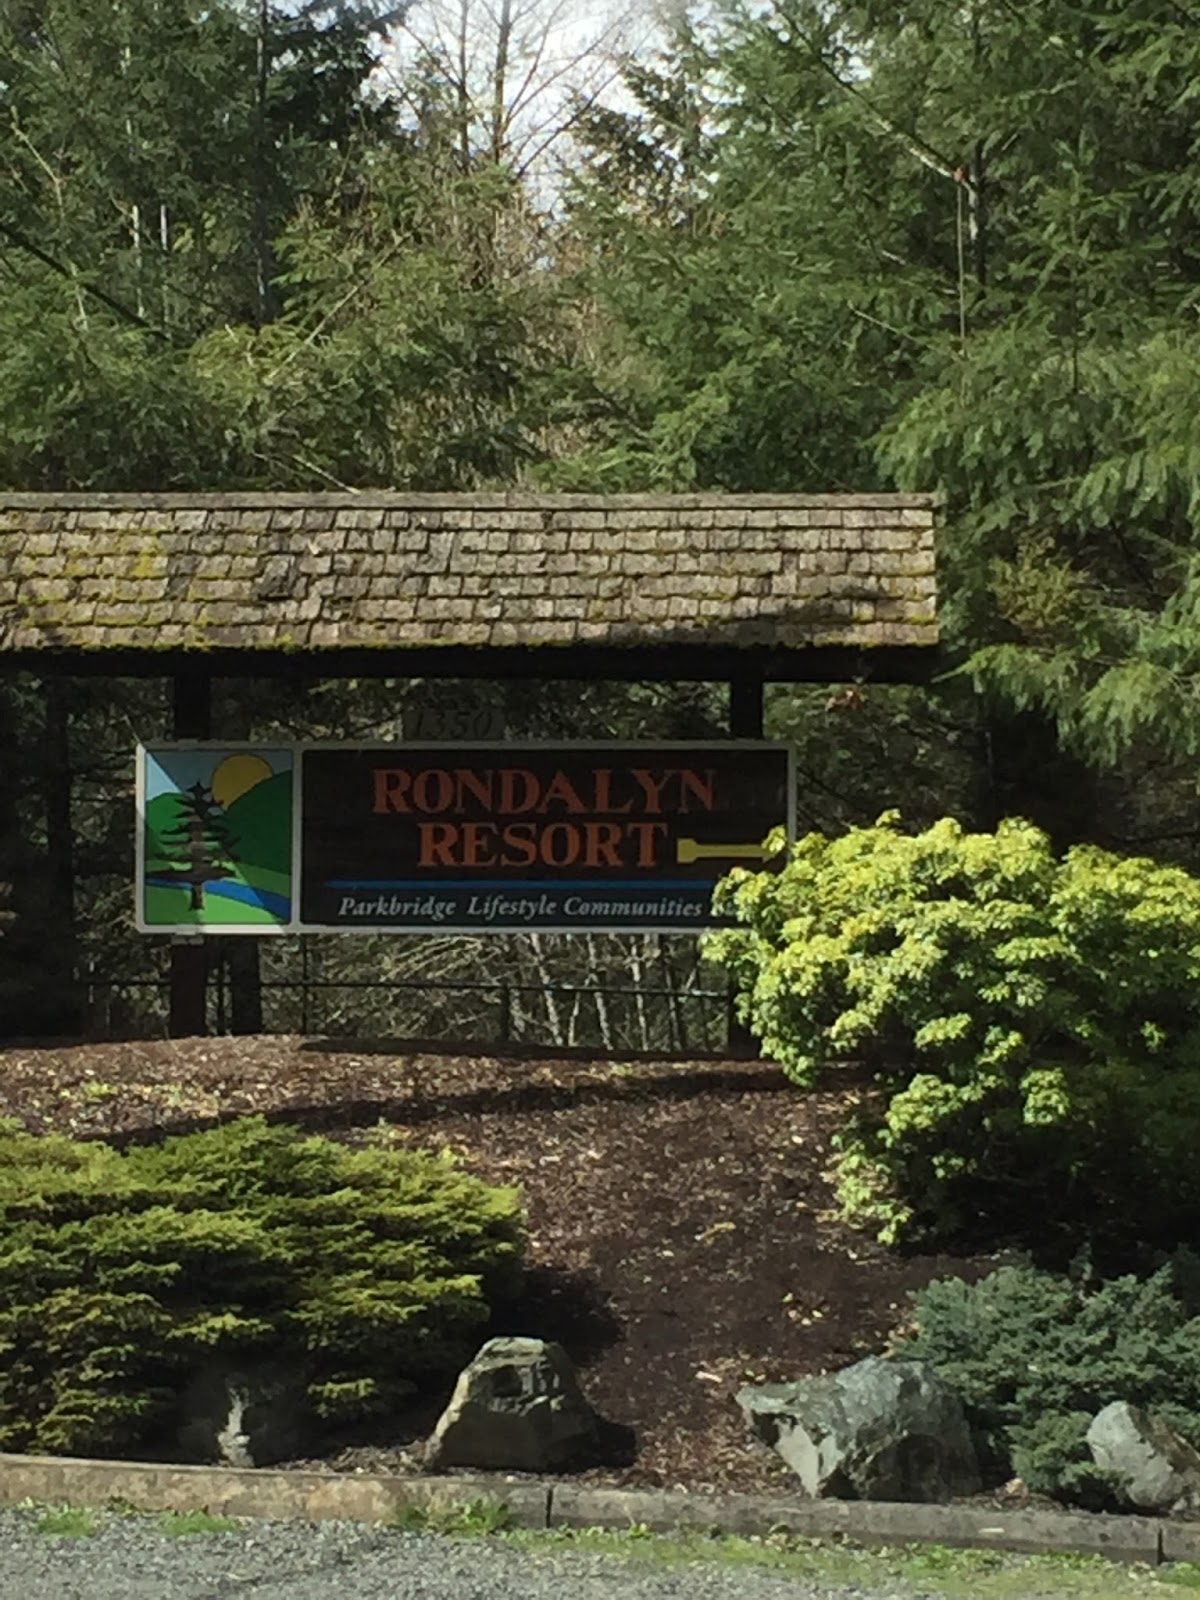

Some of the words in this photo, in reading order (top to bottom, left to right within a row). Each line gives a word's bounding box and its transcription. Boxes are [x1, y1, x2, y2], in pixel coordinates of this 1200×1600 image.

[373, 767, 718, 815] RONDALYN
[417, 821, 669, 868] RESORT
[338, 895, 456, 922] Parkbridge
[466, 894, 557, 921] Lifestyle
[563, 895, 703, 918] Communities
